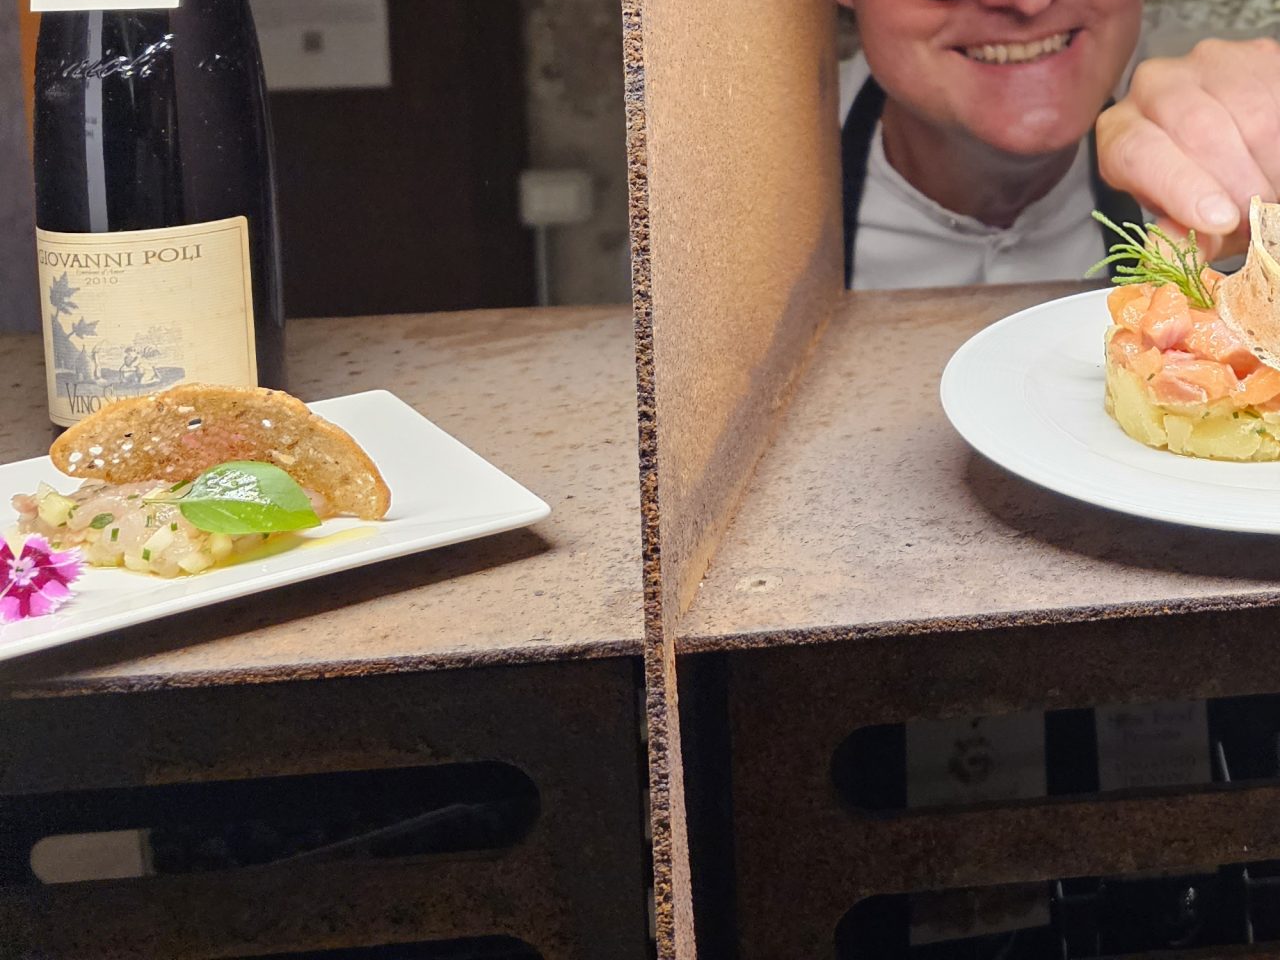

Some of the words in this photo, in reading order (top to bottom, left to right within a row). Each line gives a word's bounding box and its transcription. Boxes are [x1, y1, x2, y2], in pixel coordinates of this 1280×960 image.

[38, 248, 133, 269] GIOVANNI
[143, 244, 202, 264] POLI
[85, 276, 118, 286] 2010
